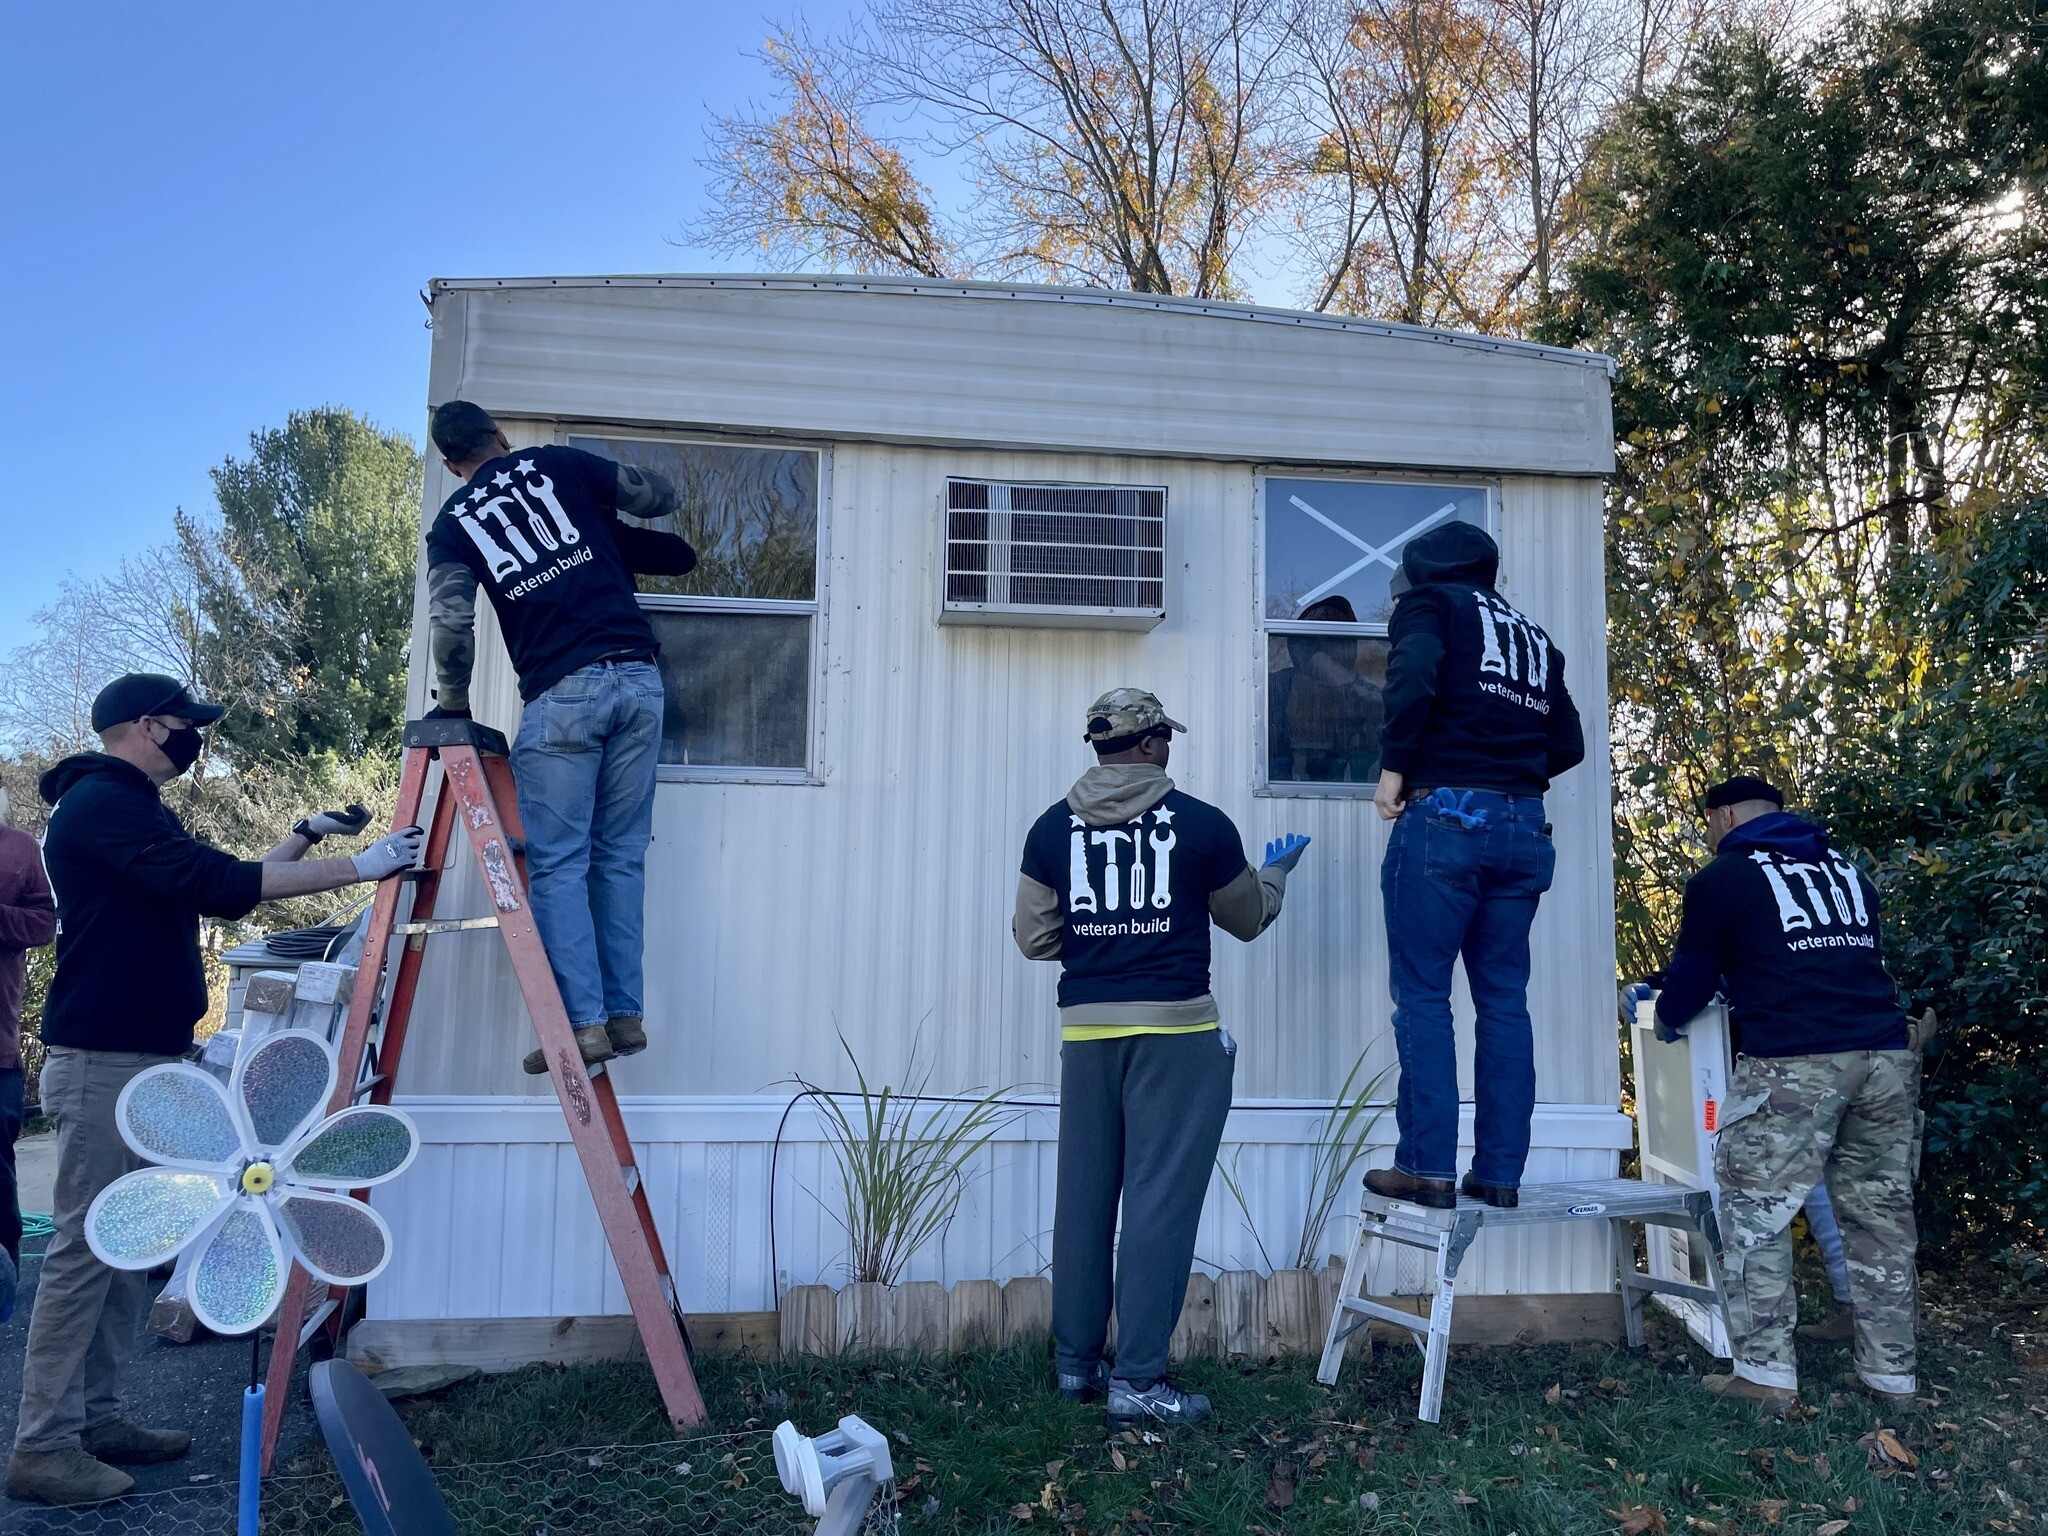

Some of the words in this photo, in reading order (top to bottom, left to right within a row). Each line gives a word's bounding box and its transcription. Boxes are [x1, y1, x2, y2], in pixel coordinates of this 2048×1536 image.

[504, 566, 560, 600] veteran
[557, 546, 593, 570] build
[1479, 681, 1522, 705] veteran
[1072, 922, 1128, 936] veteran
[1131, 917, 1170, 934] build
[1787, 936, 1846, 951] veteran
[1845, 932, 1874, 948] build
[1705, 1100, 1715, 1131] SCREEN
[1574, 1205, 1599, 1213] WERNER
